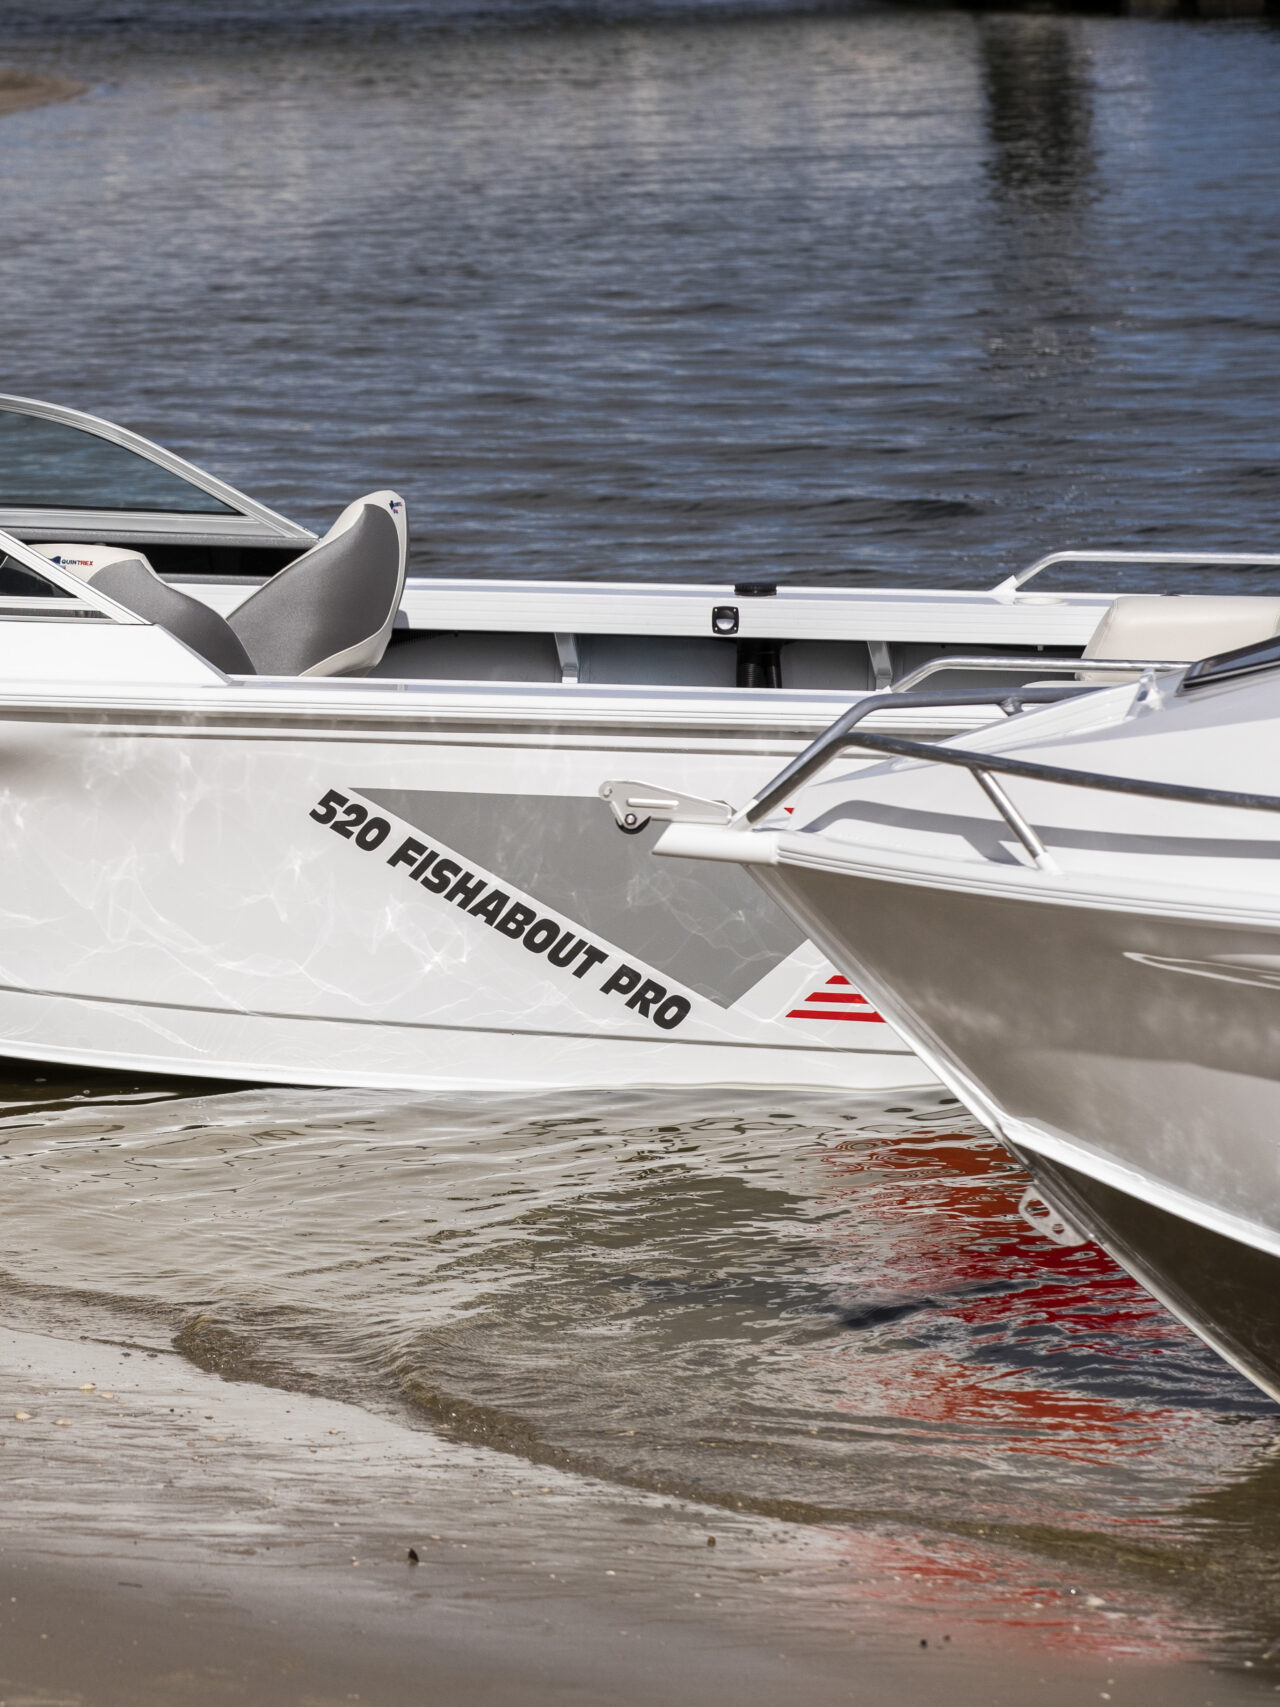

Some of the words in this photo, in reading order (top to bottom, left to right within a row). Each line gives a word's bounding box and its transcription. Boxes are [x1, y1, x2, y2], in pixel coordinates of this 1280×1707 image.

[309, 789, 391, 852] 520
[387, 836, 609, 979] FISHABOUT
[599, 964, 691, 1030] PRO
